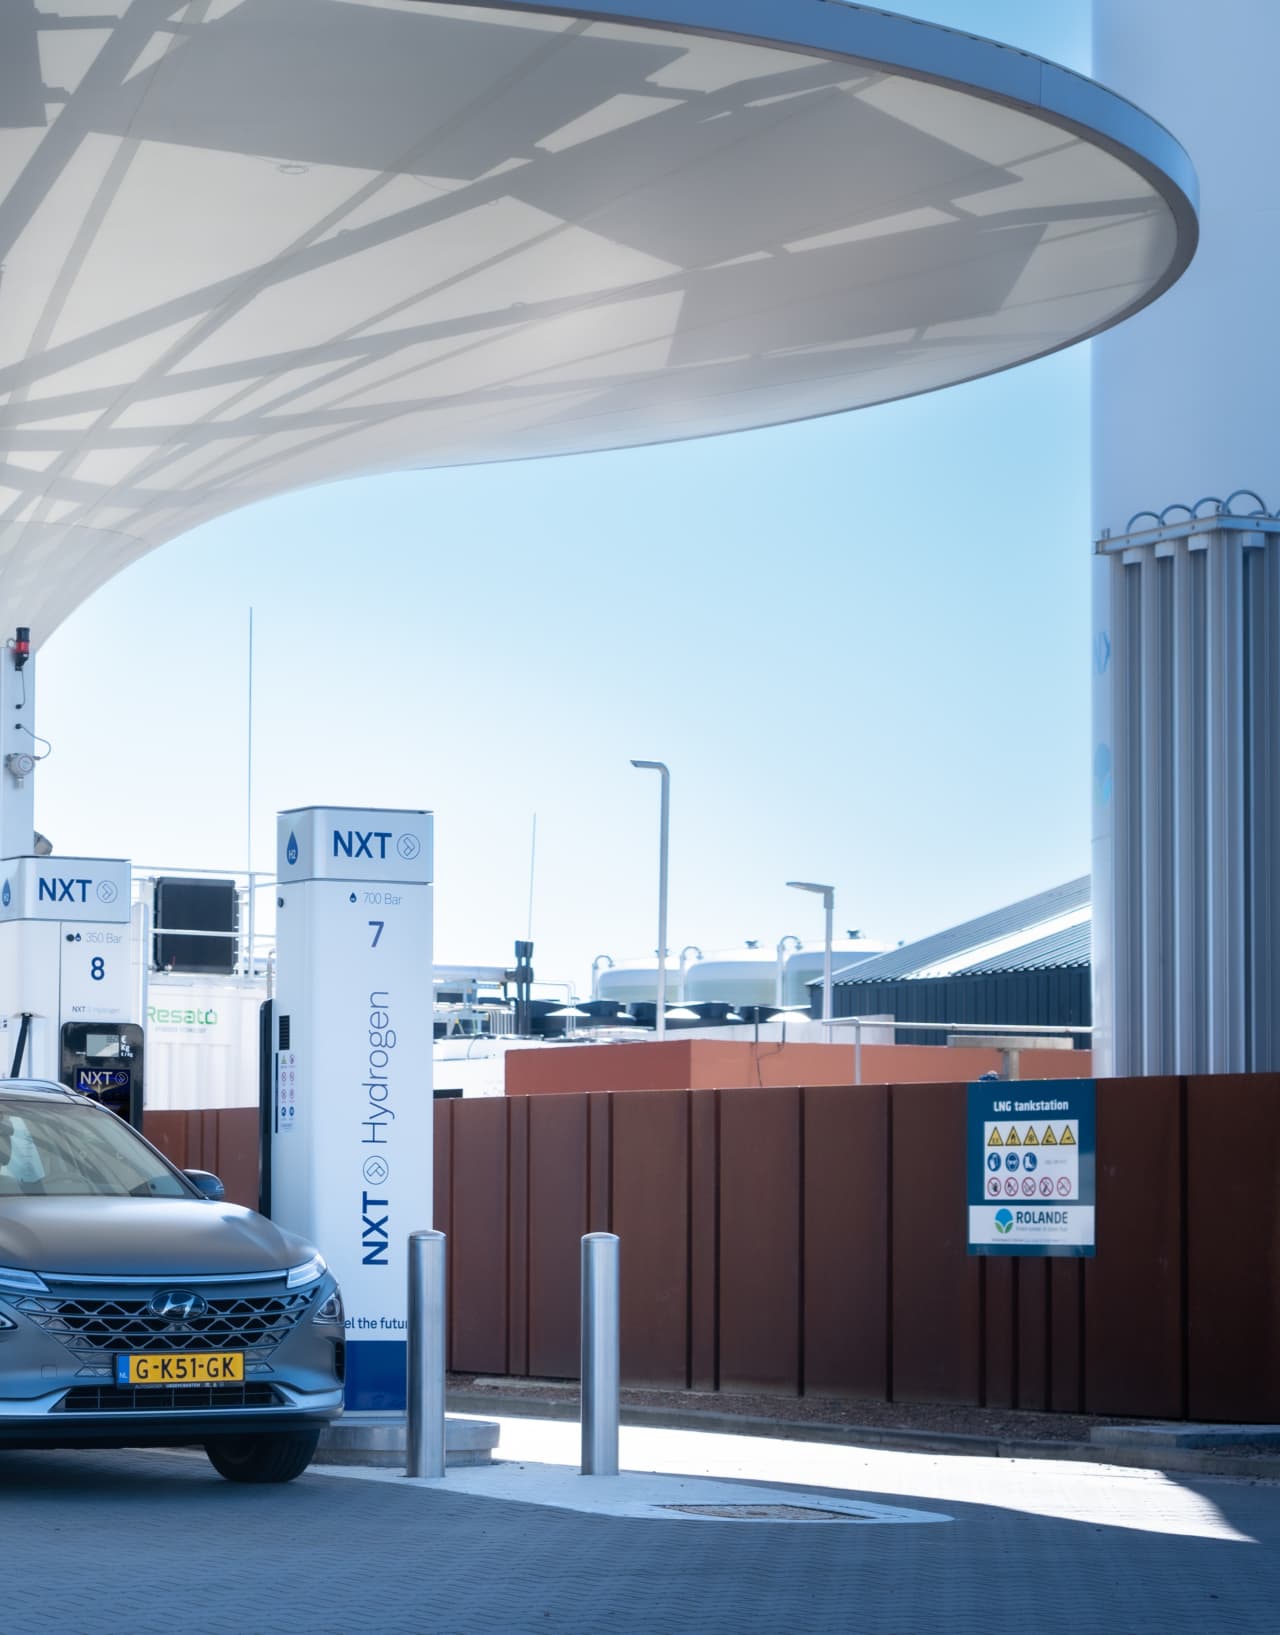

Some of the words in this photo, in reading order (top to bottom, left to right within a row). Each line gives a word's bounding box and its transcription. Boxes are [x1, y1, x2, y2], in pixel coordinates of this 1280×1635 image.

[333, 830, 392, 859] NXT
[39, 877, 92, 902] NXT
[363, 892, 382, 904] 700
[384, 893, 404, 905] Bar
[87, 932, 104, 944] 350
[106, 932, 122, 944] Bar
[368, 920, 385, 948] 7
[91, 956, 105, 981] 8
[146, 1006, 218, 1025] Resato
[361, 990, 397, 1144] Hydrogen
[80, 1071, 113, 1085] NXT
[993, 1100, 1012, 1112] LNG
[1014, 1099, 1069, 1112] tankstation
[362, 1190, 390, 1266] NXT
[1016, 1210, 1069, 1225] ROLANDE
[358, 1317, 378, 1329] the
[380, 1316, 408, 1329] futur
[136, 1356, 236, 1379] G-K51-GK
